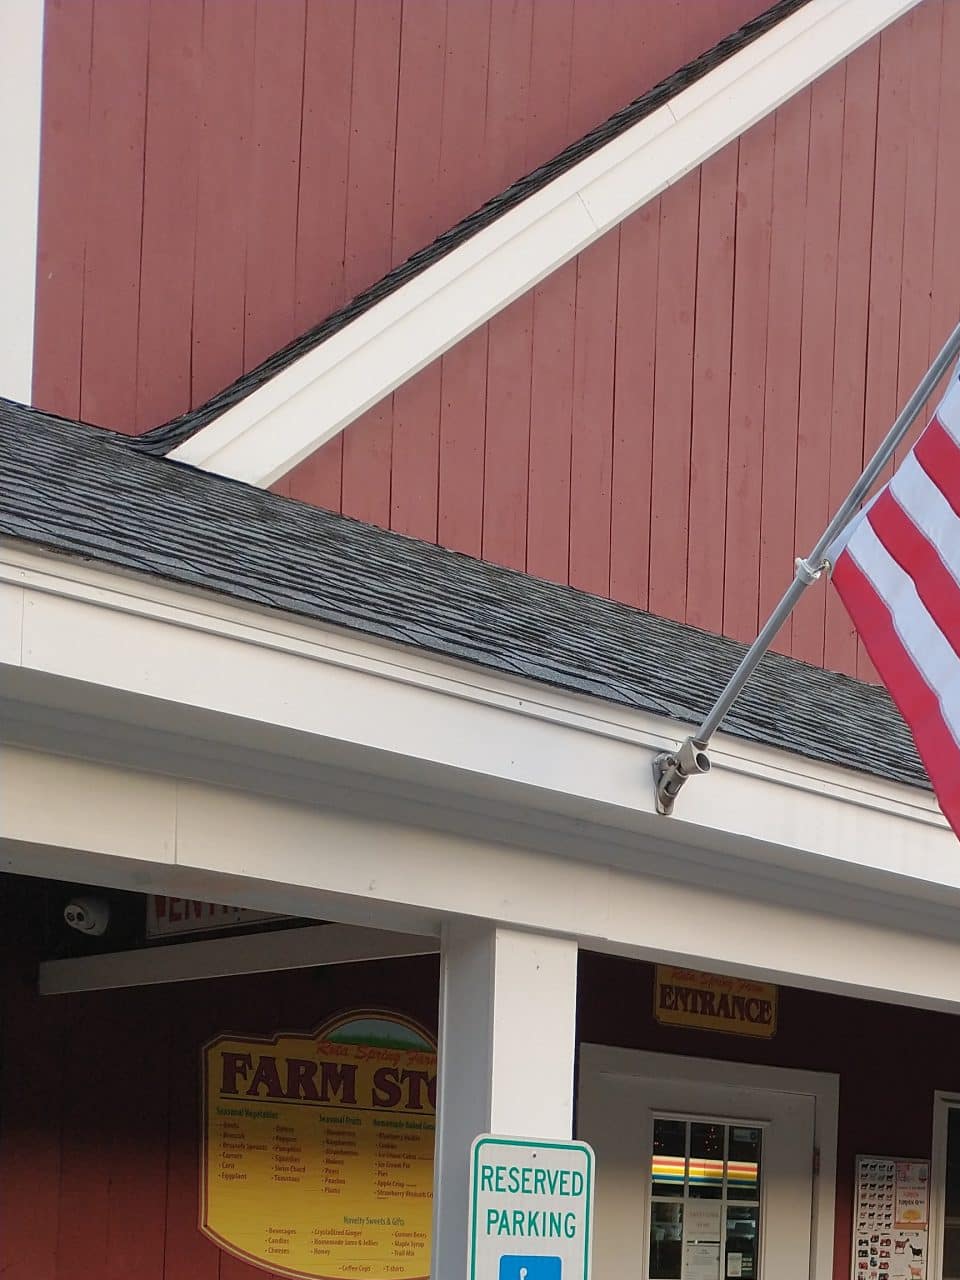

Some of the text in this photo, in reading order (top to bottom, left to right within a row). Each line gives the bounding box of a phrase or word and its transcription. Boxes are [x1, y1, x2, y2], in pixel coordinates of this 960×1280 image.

[659, 983, 773, 1025] ENTRANCE
[219, 1051, 358, 1105] FARM
[481, 1165, 584, 1197] RESERVED
[343, 1216, 365, 1226] Novelty
[365, 1217, 386, 1225] Sweets
[486, 1208, 577, 1239] PARKING
